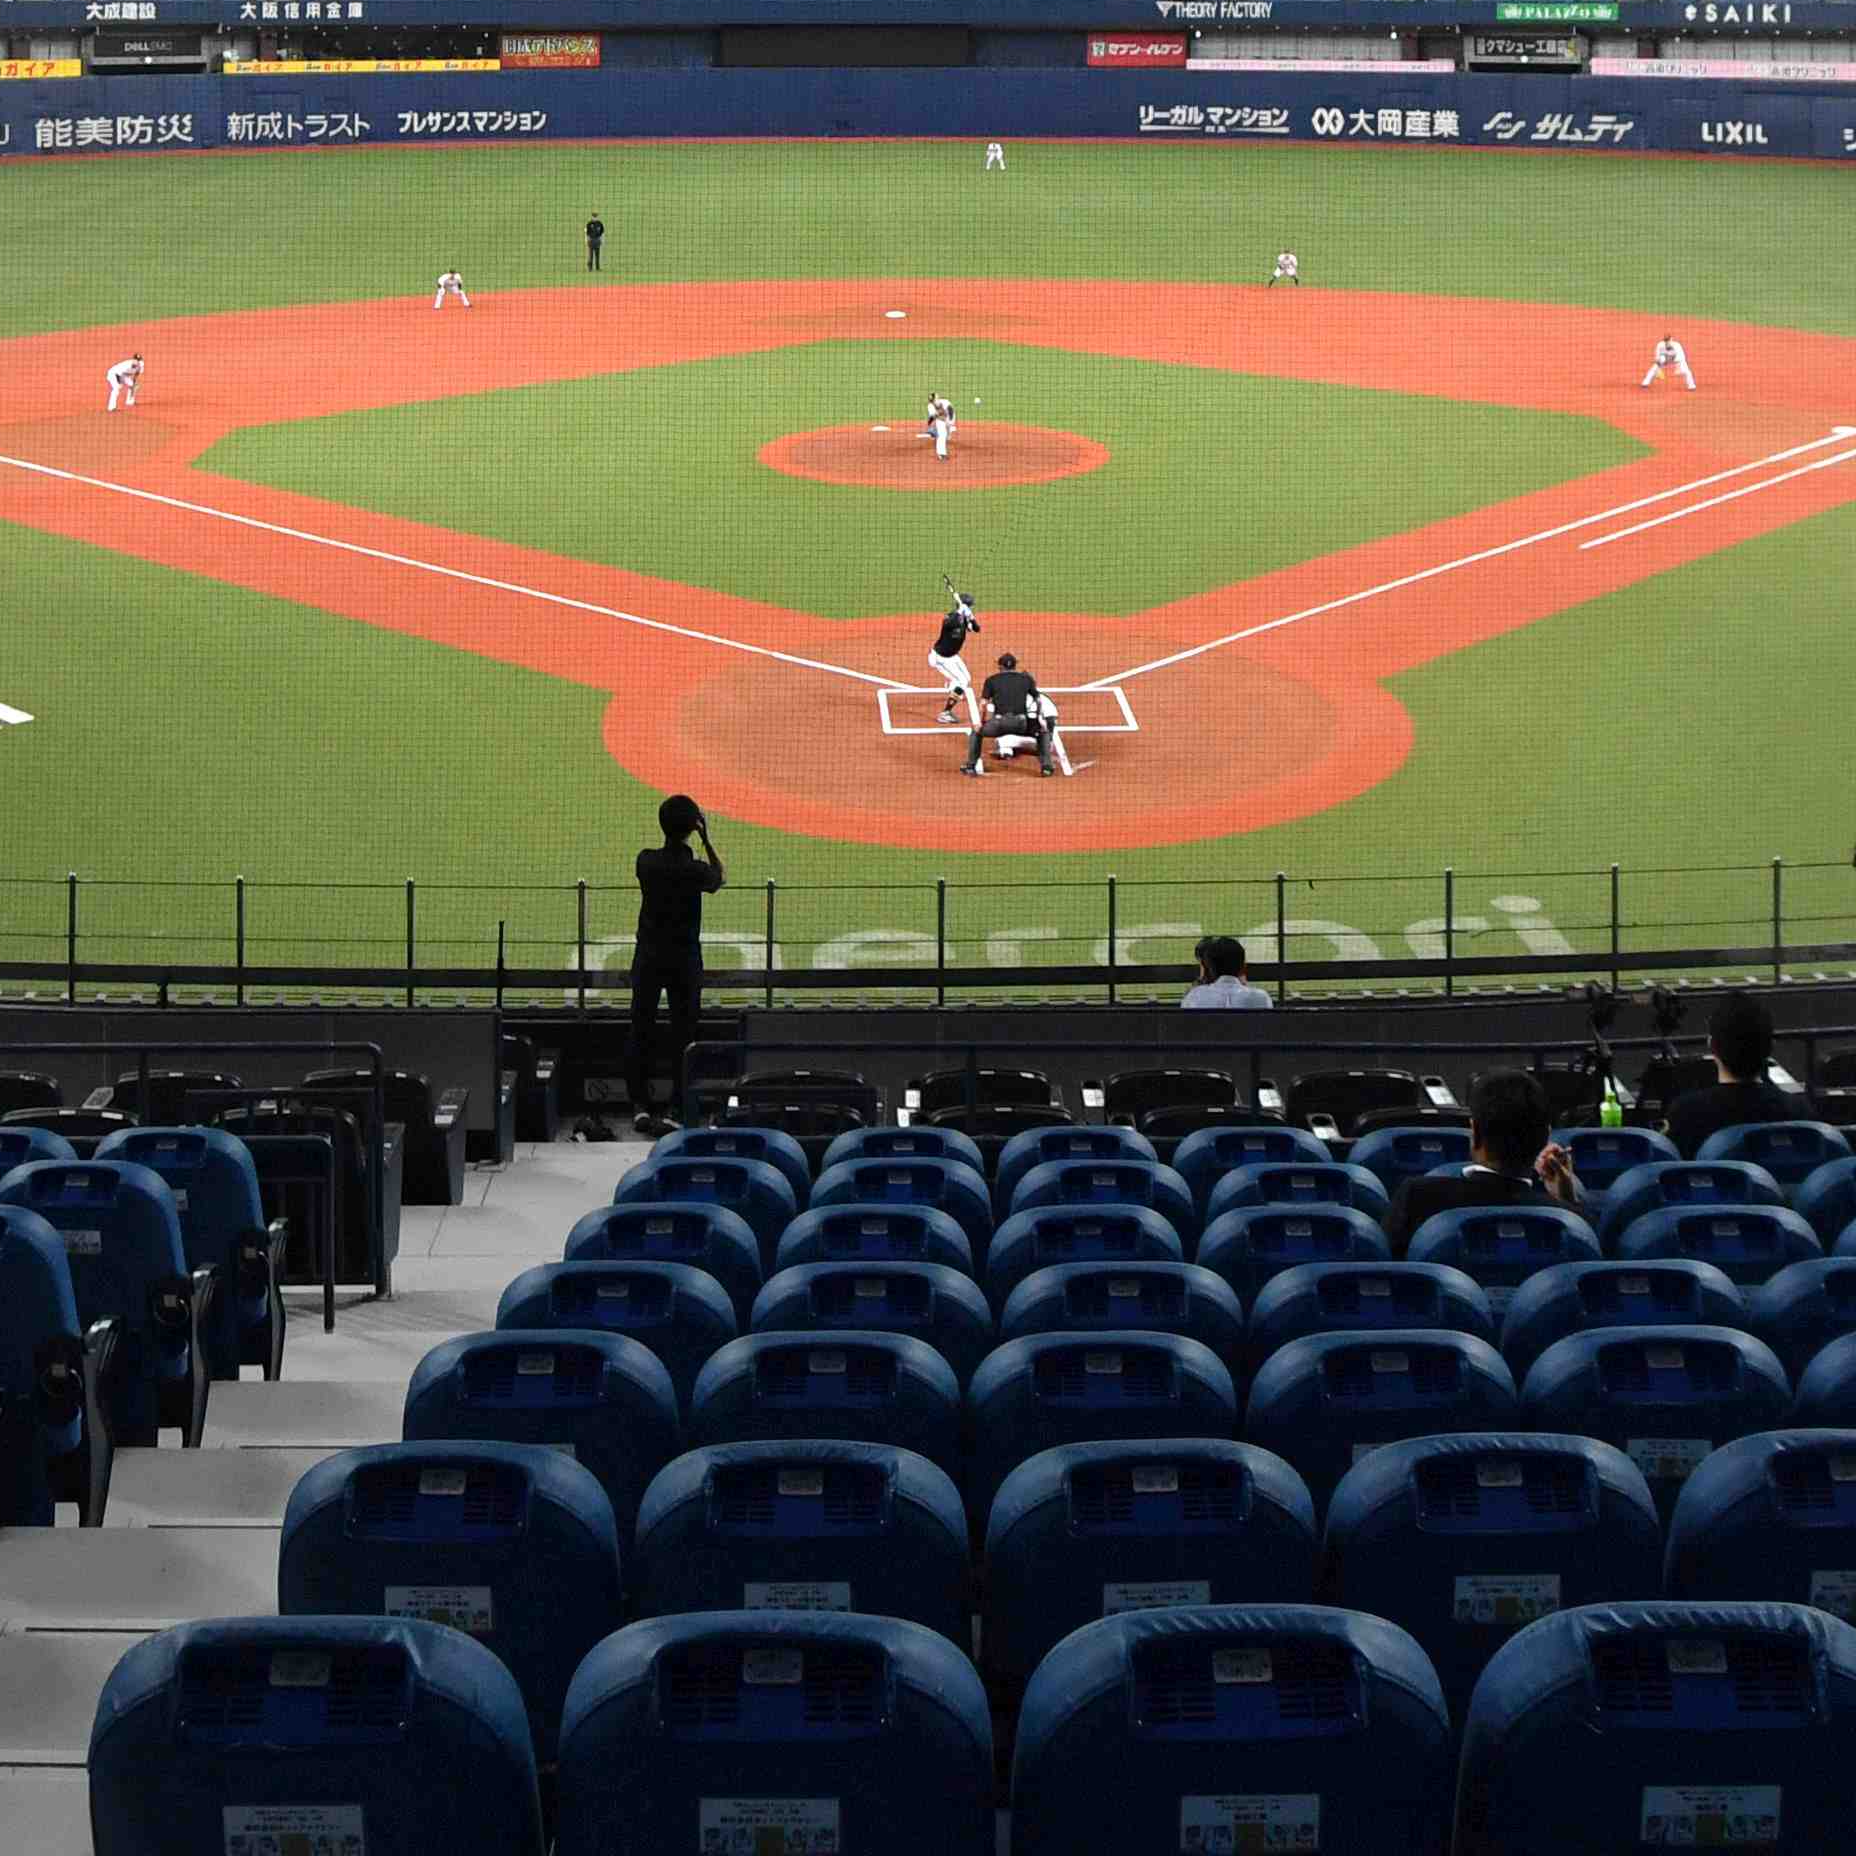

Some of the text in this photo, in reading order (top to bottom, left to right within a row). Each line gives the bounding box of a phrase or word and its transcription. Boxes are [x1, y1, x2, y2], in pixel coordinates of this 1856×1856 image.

[85, 2, 156, 20] 大成建設
[241, 2, 363, 20] 大阪信用金庫
[1174, 2, 1272, 19] THEORY FACTORY
[1704, 4, 1791, 24] SAIKI
[5, 62, 55, 76] ガイア
[35, 113, 194, 149] 能美防災
[226, 112, 370, 142] 新成トラスト
[1349, 109, 1460, 138] 大岡産業
[1531, 113, 1634, 143] サムティ
[1702, 122, 1768, 144] LIXIL
